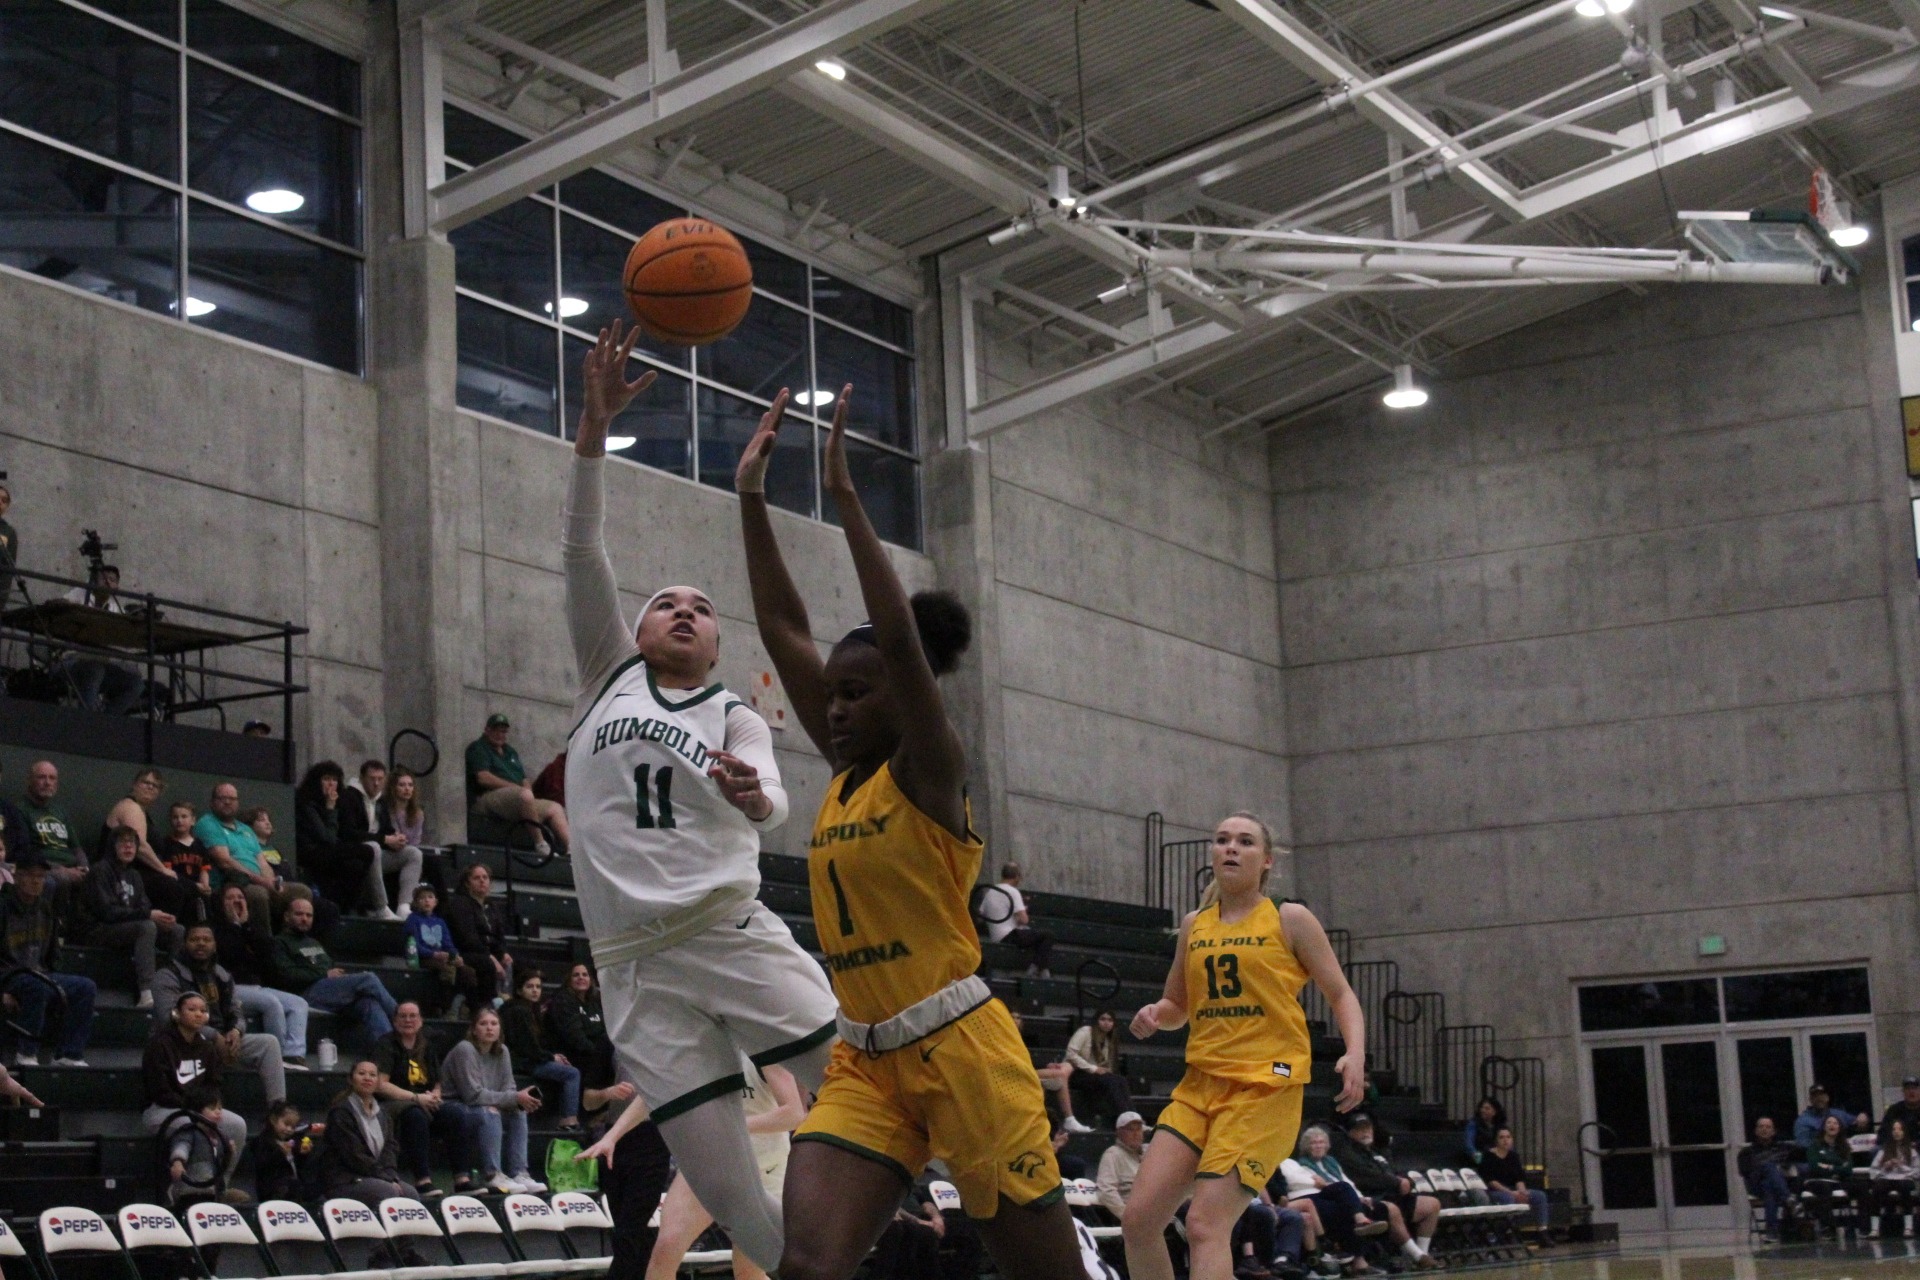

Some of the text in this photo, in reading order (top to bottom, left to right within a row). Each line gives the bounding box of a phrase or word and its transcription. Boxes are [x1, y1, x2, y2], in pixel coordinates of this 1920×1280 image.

[634, 763, 676, 829] 11
[826, 814, 889, 846] POLY
[828, 858, 854, 937] 1
[1190, 936, 1268, 951] CAL POLY
[827, 940, 912, 972] OMONA
[1204, 953, 1242, 999] 13
[1196, 1005, 1266, 1020] POMONA
[399, 1208, 428, 1221] PEPSI
[459, 1206, 487, 1219] PEPSI
[521, 1204, 550, 1216] PEPSI
[566, 1202, 596, 1214] PEPSI
[141, 1216, 175, 1229] PEPSI
[207, 1213, 241, 1227] PEPSI
[277, 1212, 308, 1225] PEPSI
[342, 1209, 372, 1222] PEPSI
[64, 1218, 103, 1233] PEPSI
